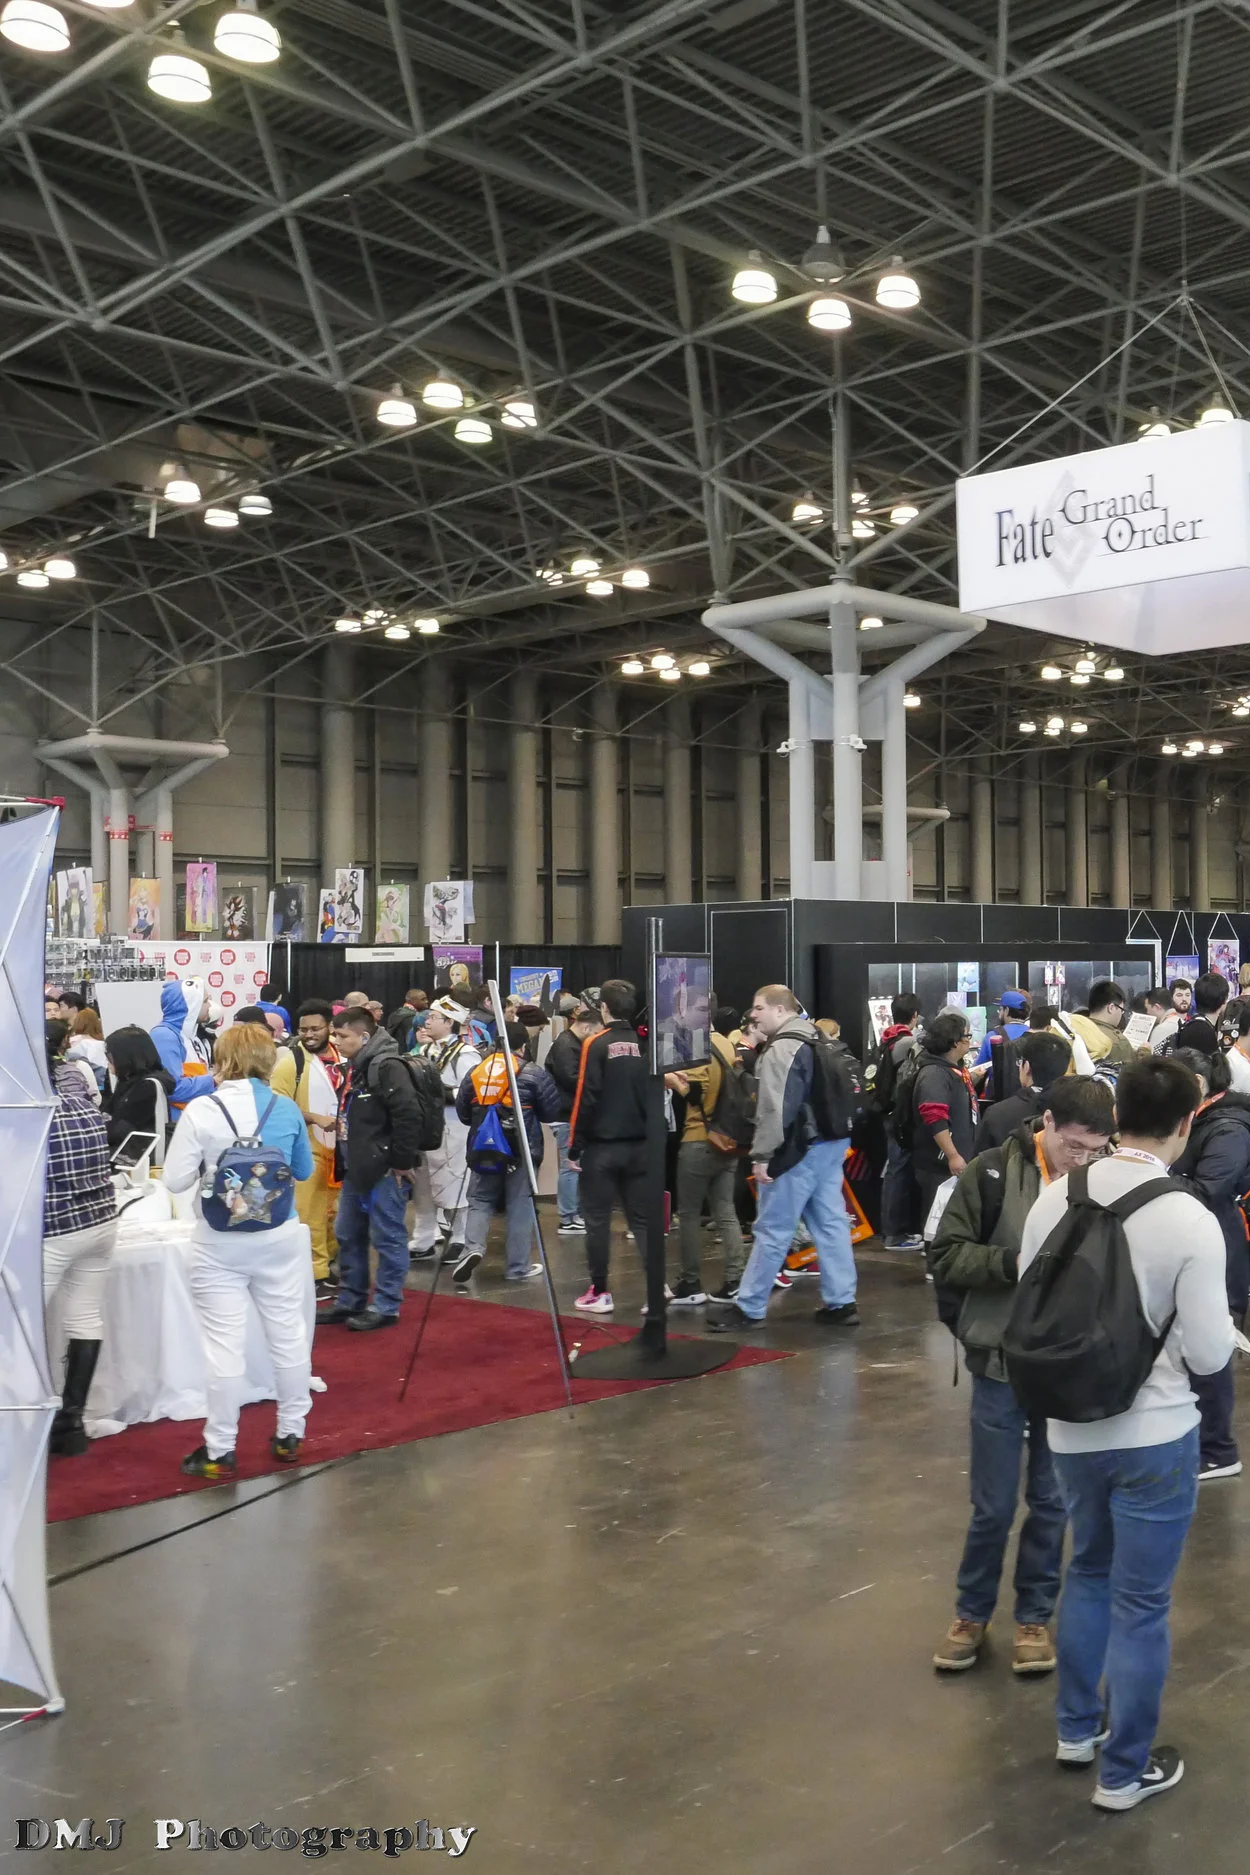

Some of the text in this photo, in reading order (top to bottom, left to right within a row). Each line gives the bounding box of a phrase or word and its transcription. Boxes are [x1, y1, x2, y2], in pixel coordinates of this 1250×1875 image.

[1058, 474, 1159, 525] Grand
[995, 506, 1054, 567] Fate
[1102, 508, 1204, 553] Order
